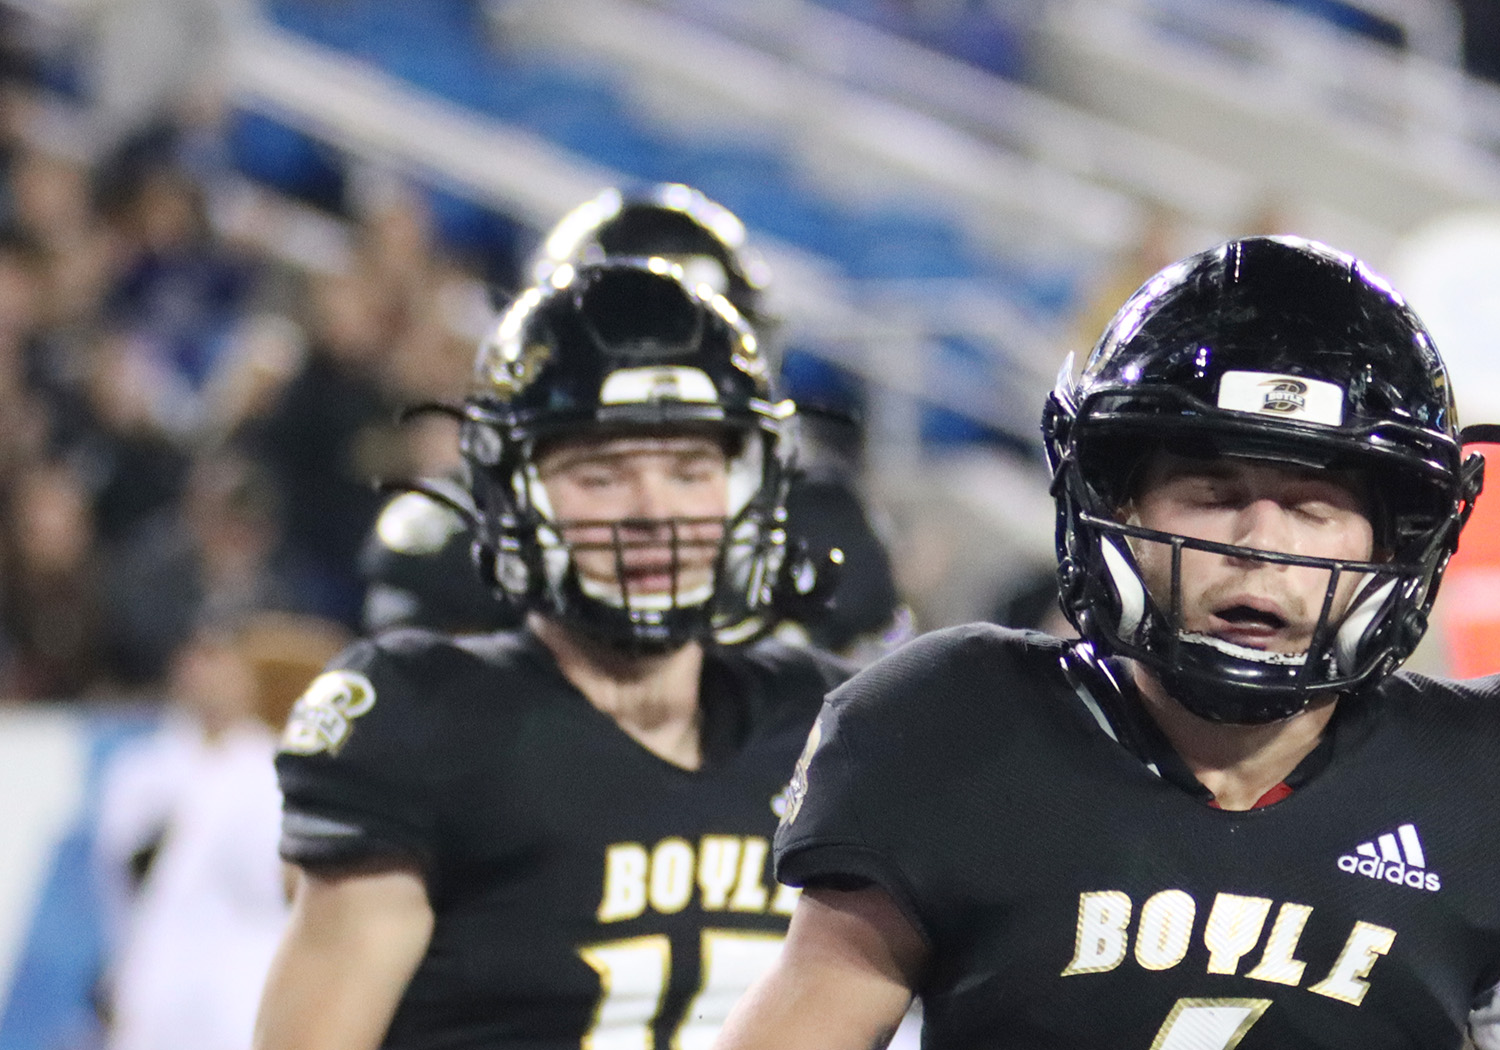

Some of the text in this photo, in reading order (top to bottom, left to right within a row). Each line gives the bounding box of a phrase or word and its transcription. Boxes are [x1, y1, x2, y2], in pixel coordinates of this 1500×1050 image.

[597, 833, 802, 924] BOYL
[1337, 854, 1441, 892] adidas
[1060, 889, 1397, 1007] BOYLE
